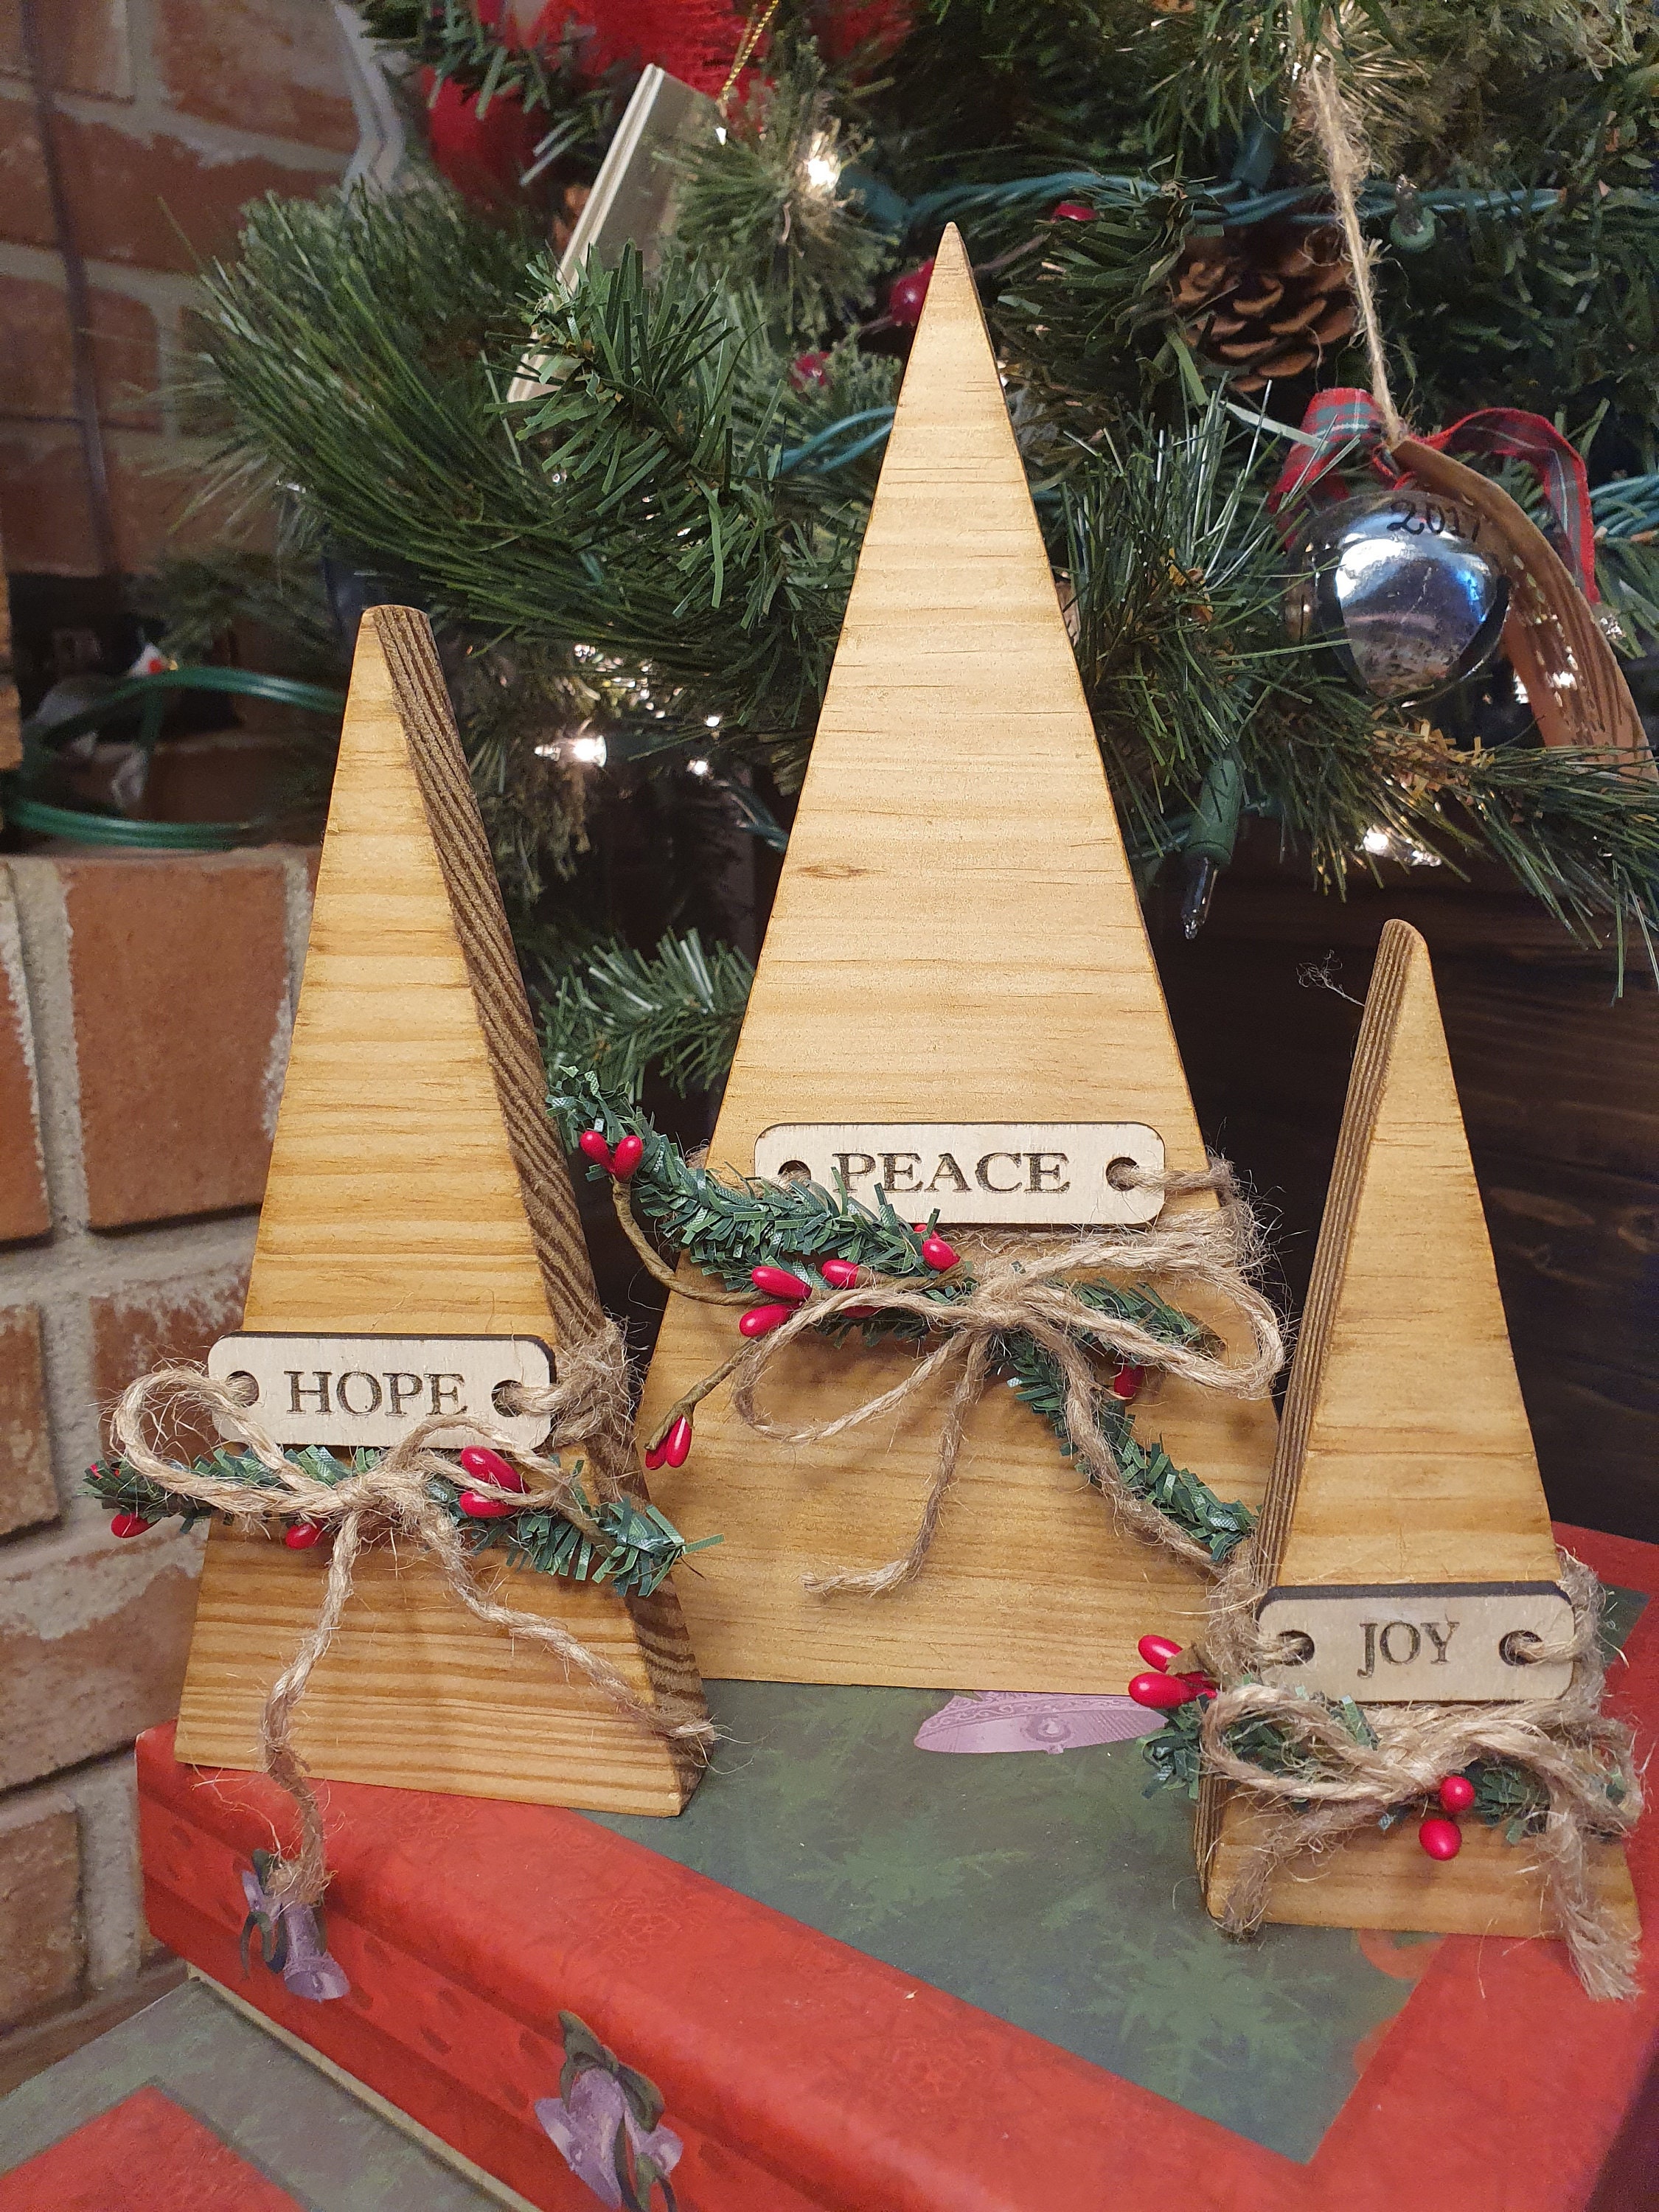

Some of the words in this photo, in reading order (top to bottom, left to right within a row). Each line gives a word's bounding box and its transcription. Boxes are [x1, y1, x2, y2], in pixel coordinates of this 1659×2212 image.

[832, 1152, 1071, 1194] PEACE
[284, 1370, 469, 1417] HOPE
[1357, 1621, 1460, 1680] JOY
